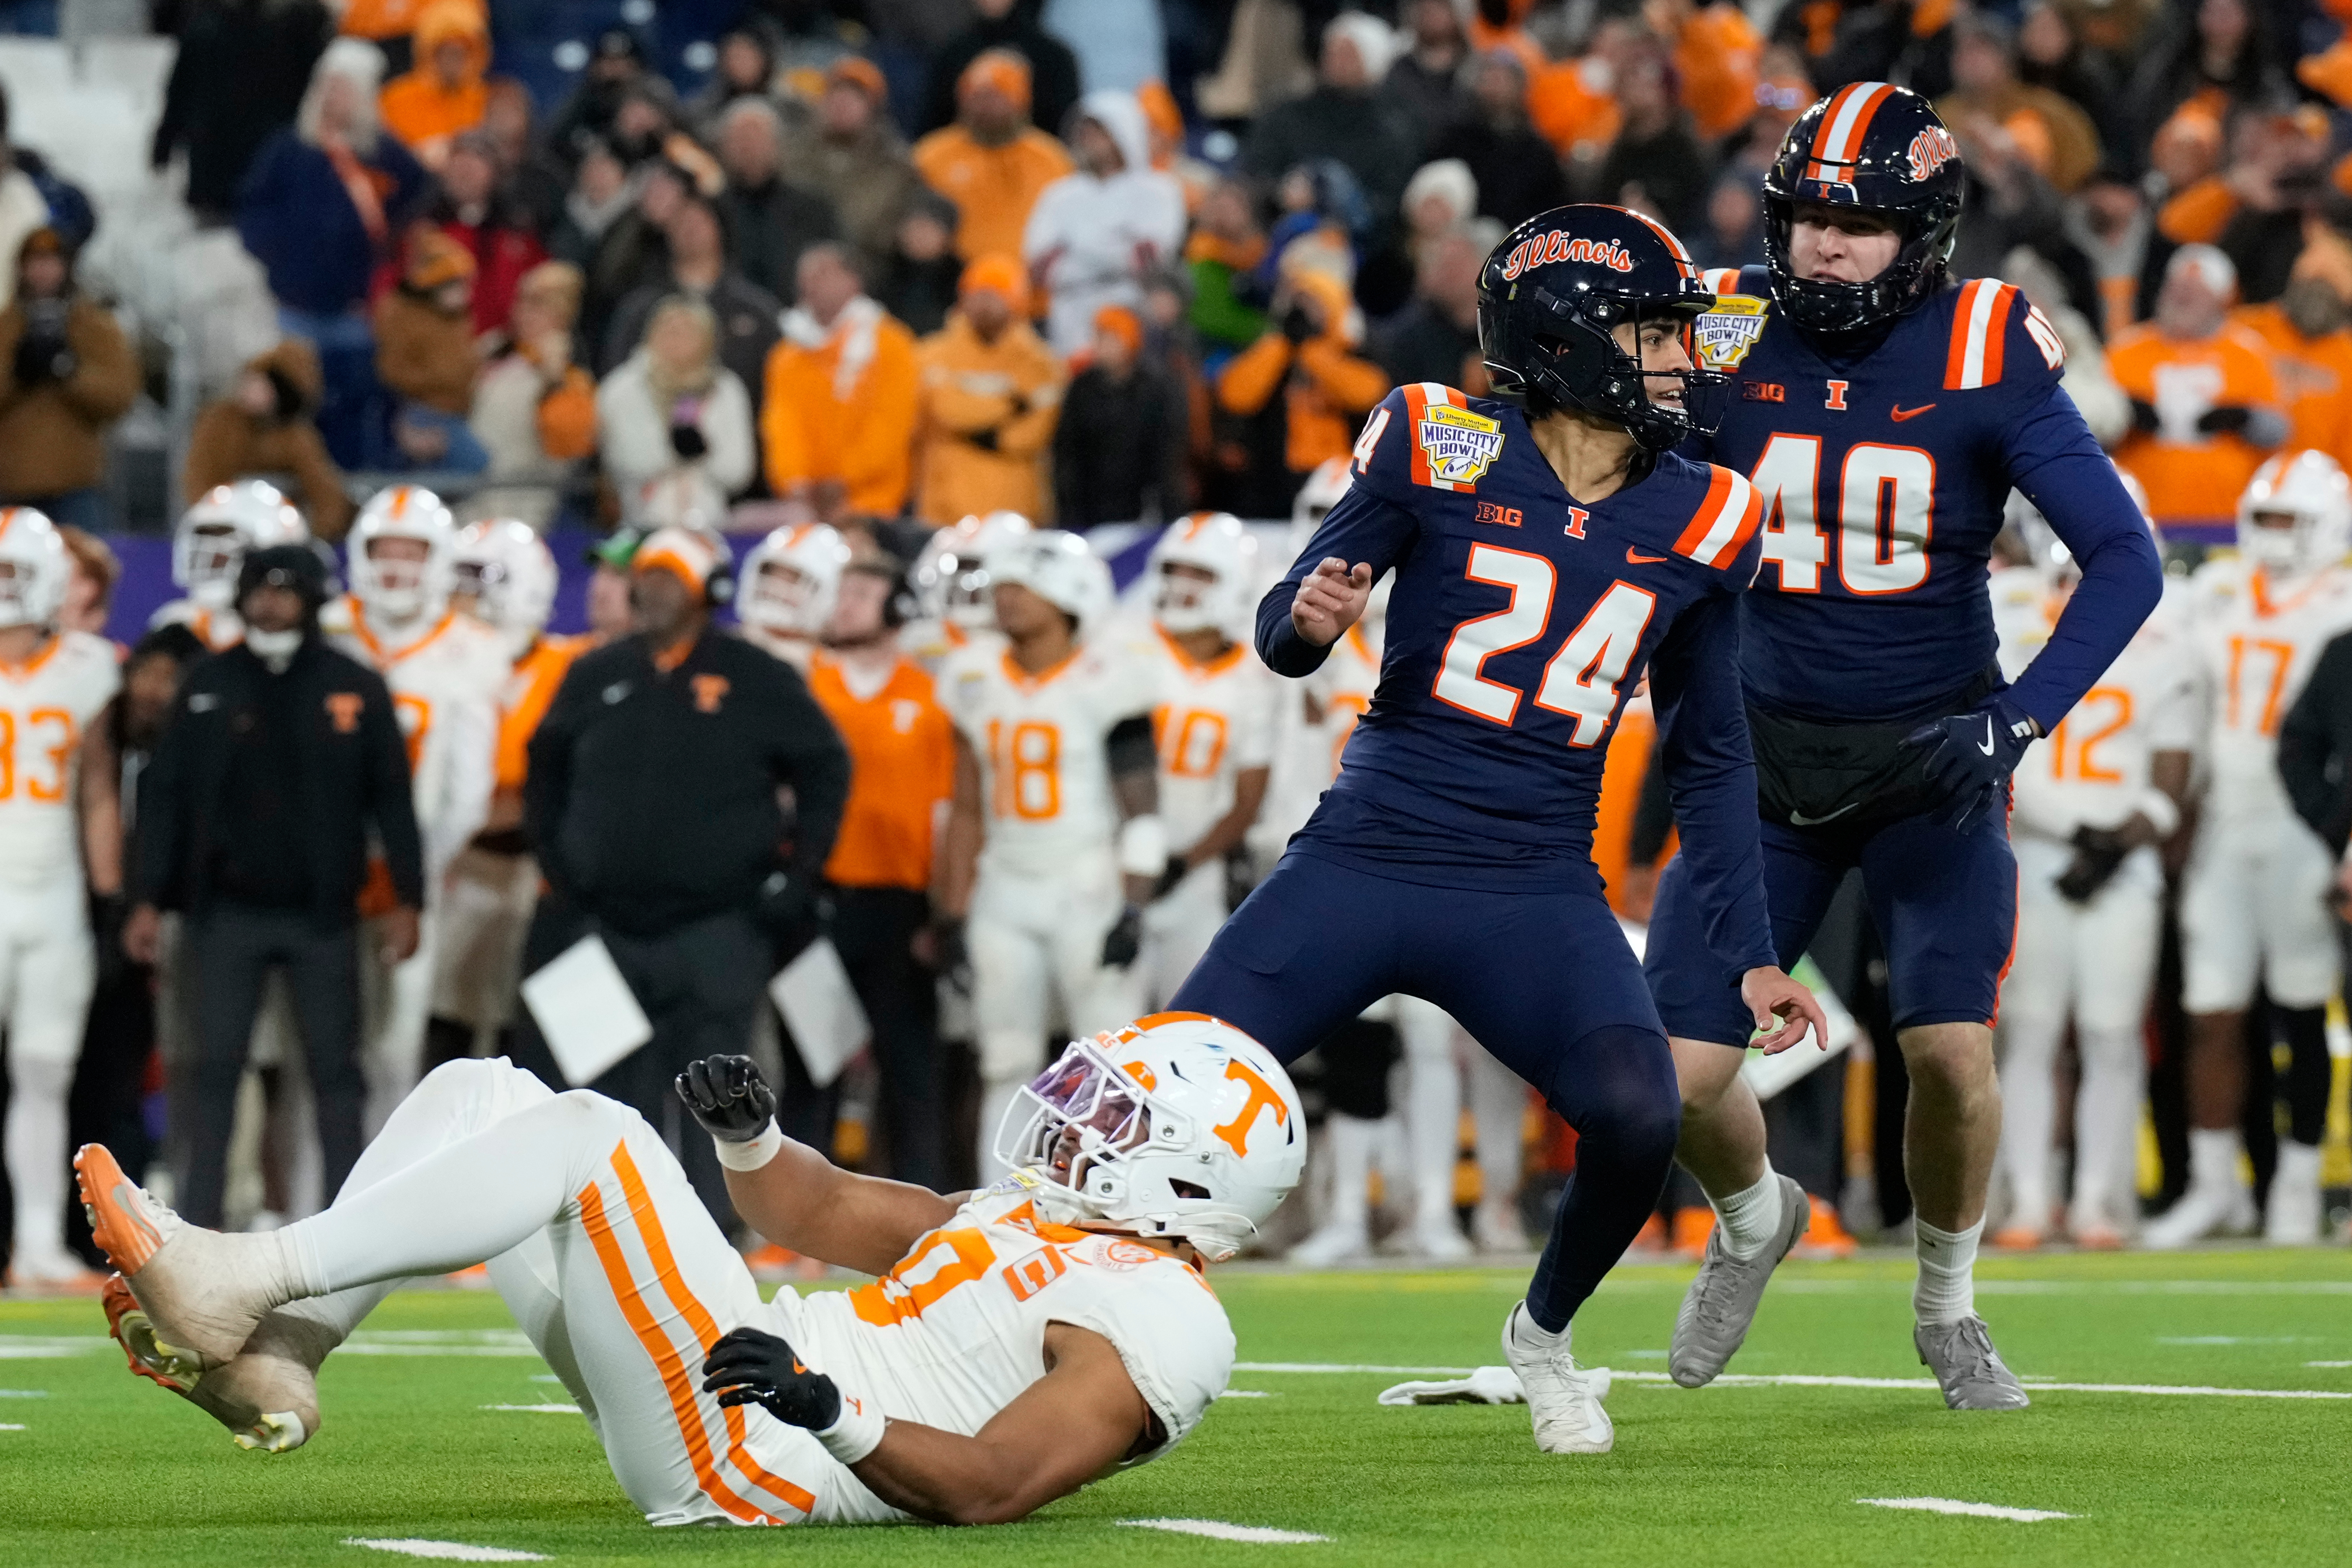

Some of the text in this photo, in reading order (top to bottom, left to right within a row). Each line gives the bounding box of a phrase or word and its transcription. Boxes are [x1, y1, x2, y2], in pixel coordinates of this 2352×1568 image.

[1501, 229, 1633, 281] Illinois
[1695, 316, 1761, 335] MUSIC CITY
[1707, 330, 1740, 343] BOWL
[1825, 379, 1849, 411] I
[1424, 424, 1499, 453] MUSIC CITY
[1446, 413, 1488, 427] Liberty Mutual
[1439, 443, 1479, 461] BOWL
[1564, 505, 1589, 540] I
[1749, 432, 1936, 595] 40
[1431, 541, 1656, 748] 24
[2227, 633, 2296, 736] 17
[2050, 685, 2133, 784] 12
[986, 719, 1062, 820] 18
[1213, 1057, 1288, 1159] T
